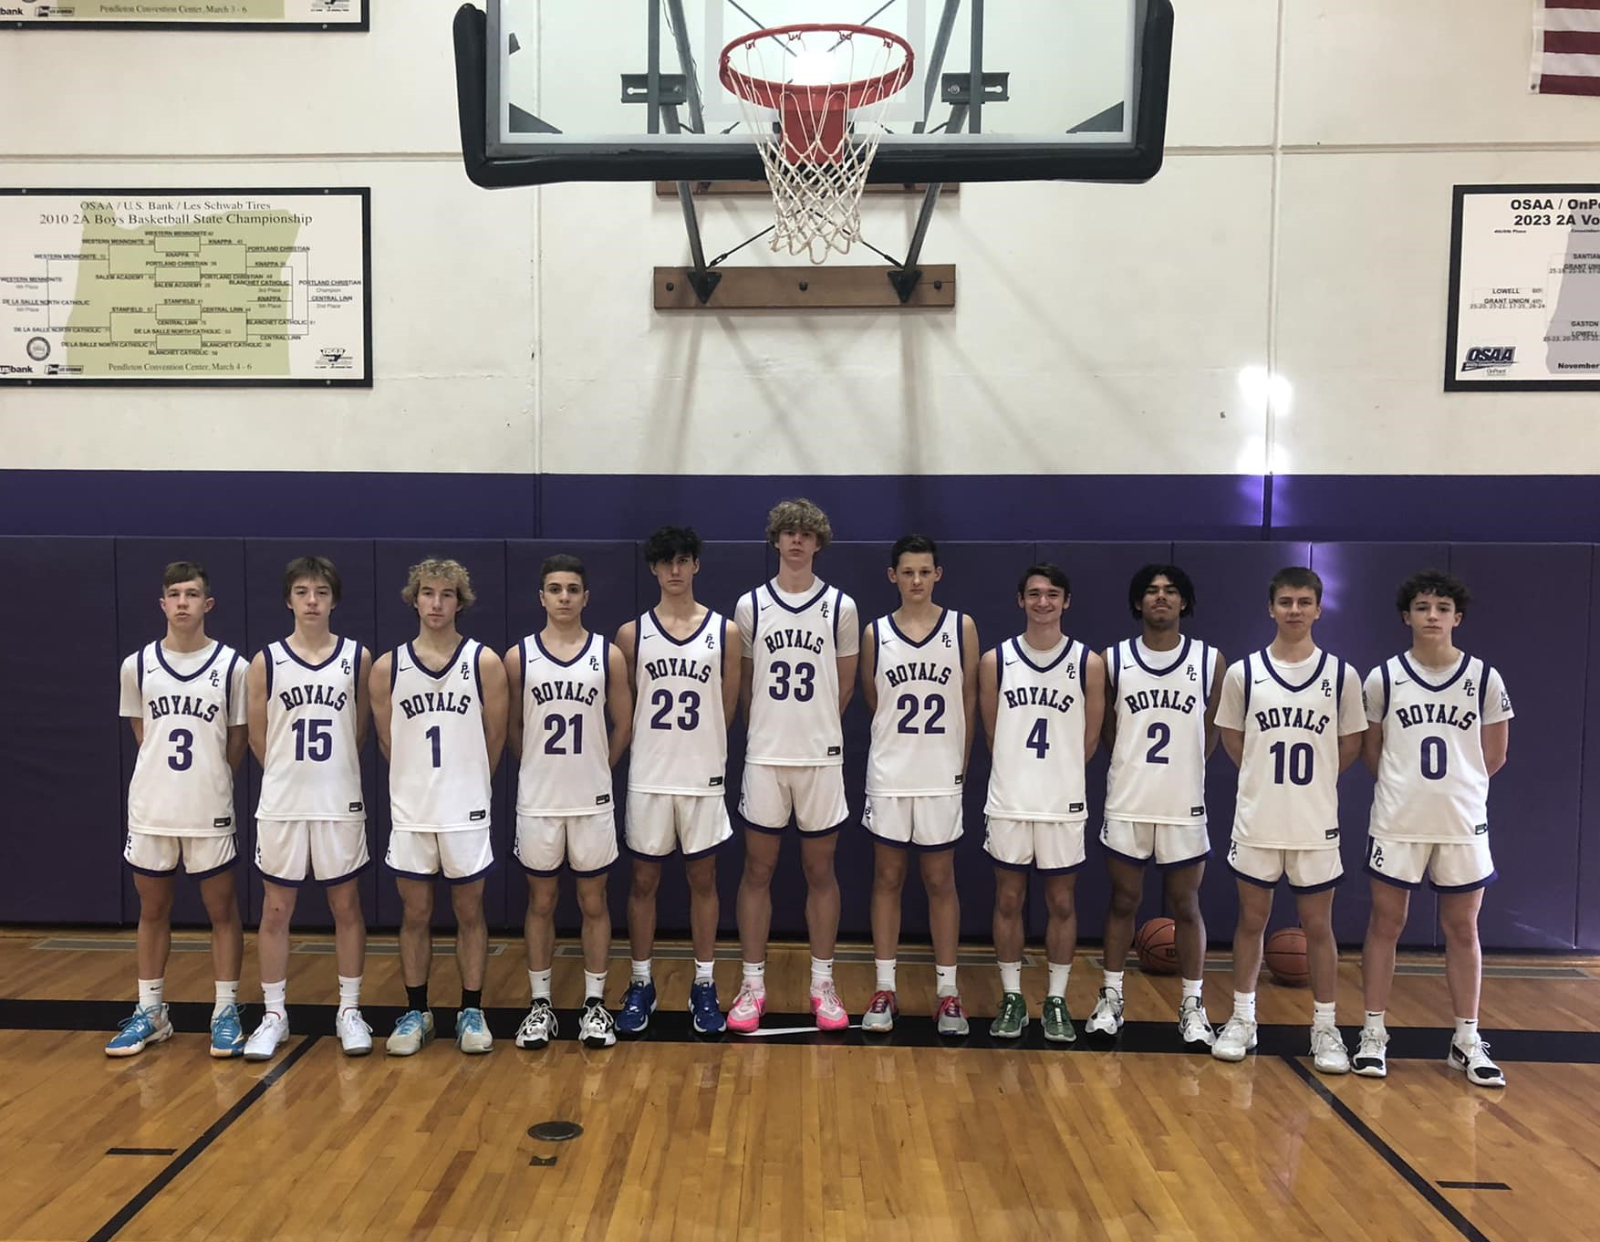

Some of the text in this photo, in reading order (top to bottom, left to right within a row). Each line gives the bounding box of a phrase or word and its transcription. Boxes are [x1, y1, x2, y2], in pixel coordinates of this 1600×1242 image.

[80, 201, 114, 210] OSAA
[124, 201, 144, 210] U.S.
[149, 201, 174, 210] Bank
[184, 201, 201, 210] Les
[204, 201, 243, 210] Schwab
[246, 201, 271, 210] Tires
[1511, 199, 1554, 210] OSAA
[1558, 199, 1563, 210] /
[40, 213, 313, 226] 2010 2A Boys Basketball State Championship
[1514, 215, 1551, 225] 2023
[1556, 215, 1576, 225] 2A
[185, 363, 210, 371] Center,
[1466, 346, 1516, 362] OSAA
[764, 629, 824, 655] ROYALS
[645, 658, 712, 684] ROYALS
[769, 661, 816, 702] 33
[885, 662, 952, 688] ROYALS
[279, 684, 348, 712] ROYALS
[400, 692, 471, 720] ROYALS
[531, 680, 598, 706] ROYALS
[1004, 686, 1074, 713] ROYALS
[1124, 689, 1196, 715] ROYALS
[148, 695, 220, 723] ROYALS
[650, 689, 700, 731] 23
[897, 693, 946, 735] 22
[1255, 707, 1330, 735] ROYALS
[1396, 703, 1477, 731] ROYALS
[291, 718, 333, 762] 15
[425, 725, 441, 768] 1
[544, 713, 583, 755] 21
[1025, 718, 1050, 759] 4
[1145, 722, 1171, 765] 2
[167, 728, 194, 771] 3
[1269, 741, 1314, 786] 10
[1420, 736, 1447, 780] 0
